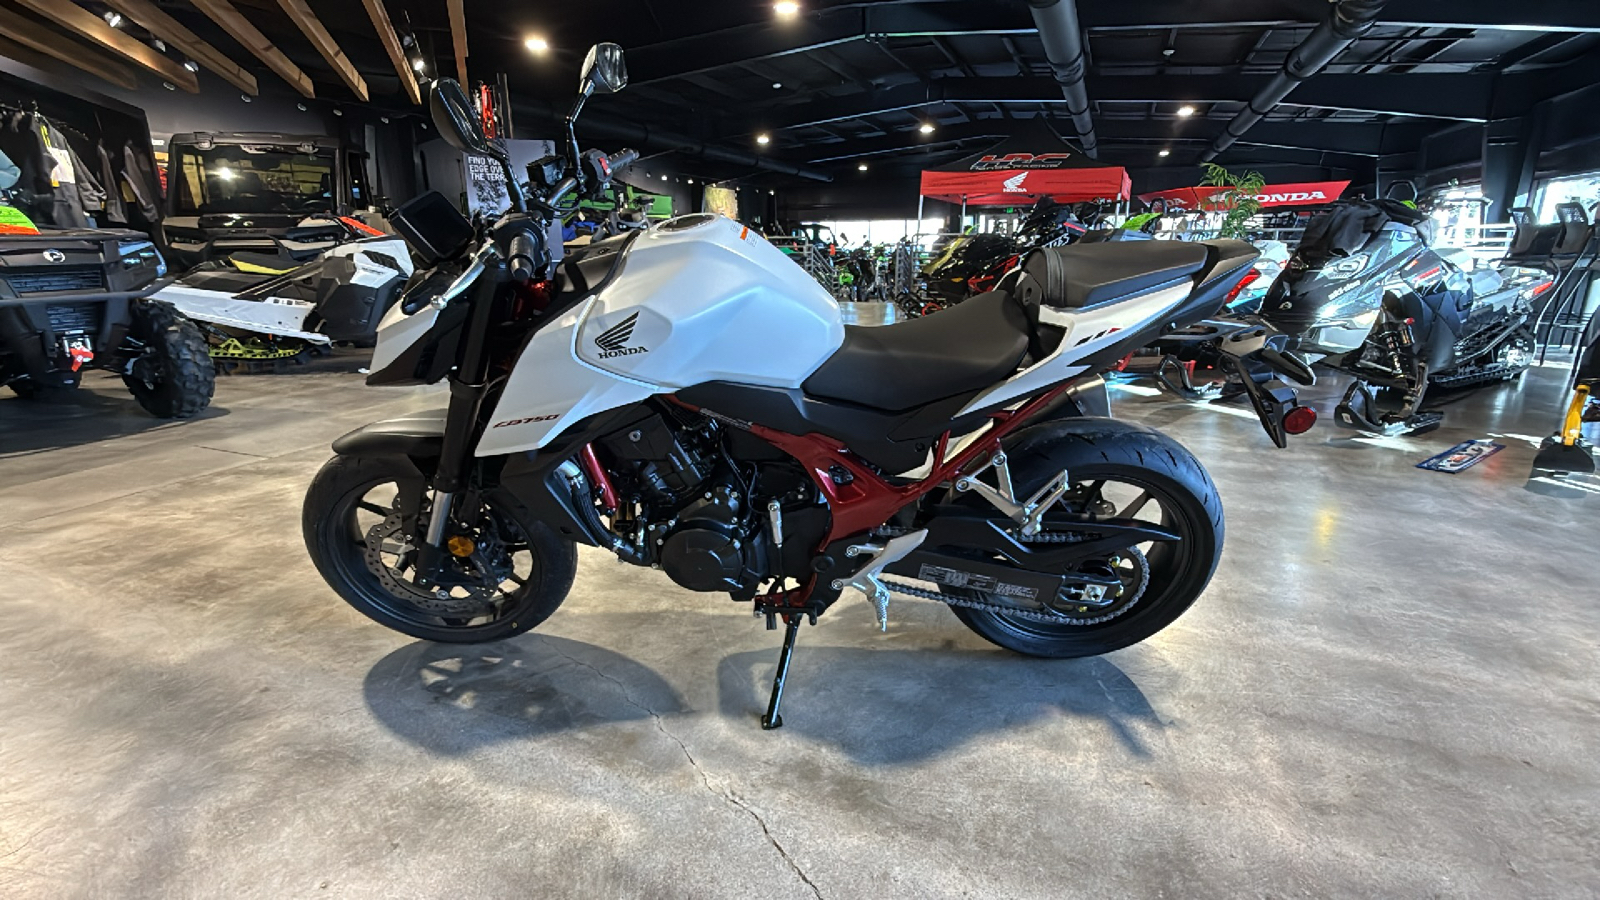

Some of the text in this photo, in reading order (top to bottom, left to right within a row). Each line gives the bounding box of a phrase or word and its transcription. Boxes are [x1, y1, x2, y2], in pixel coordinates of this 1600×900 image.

[468, 156, 486, 165] FIND
[469, 165, 504, 174] EDGE OVE
[471, 173, 485, 181] THE
[598, 346, 649, 359] HONDA
